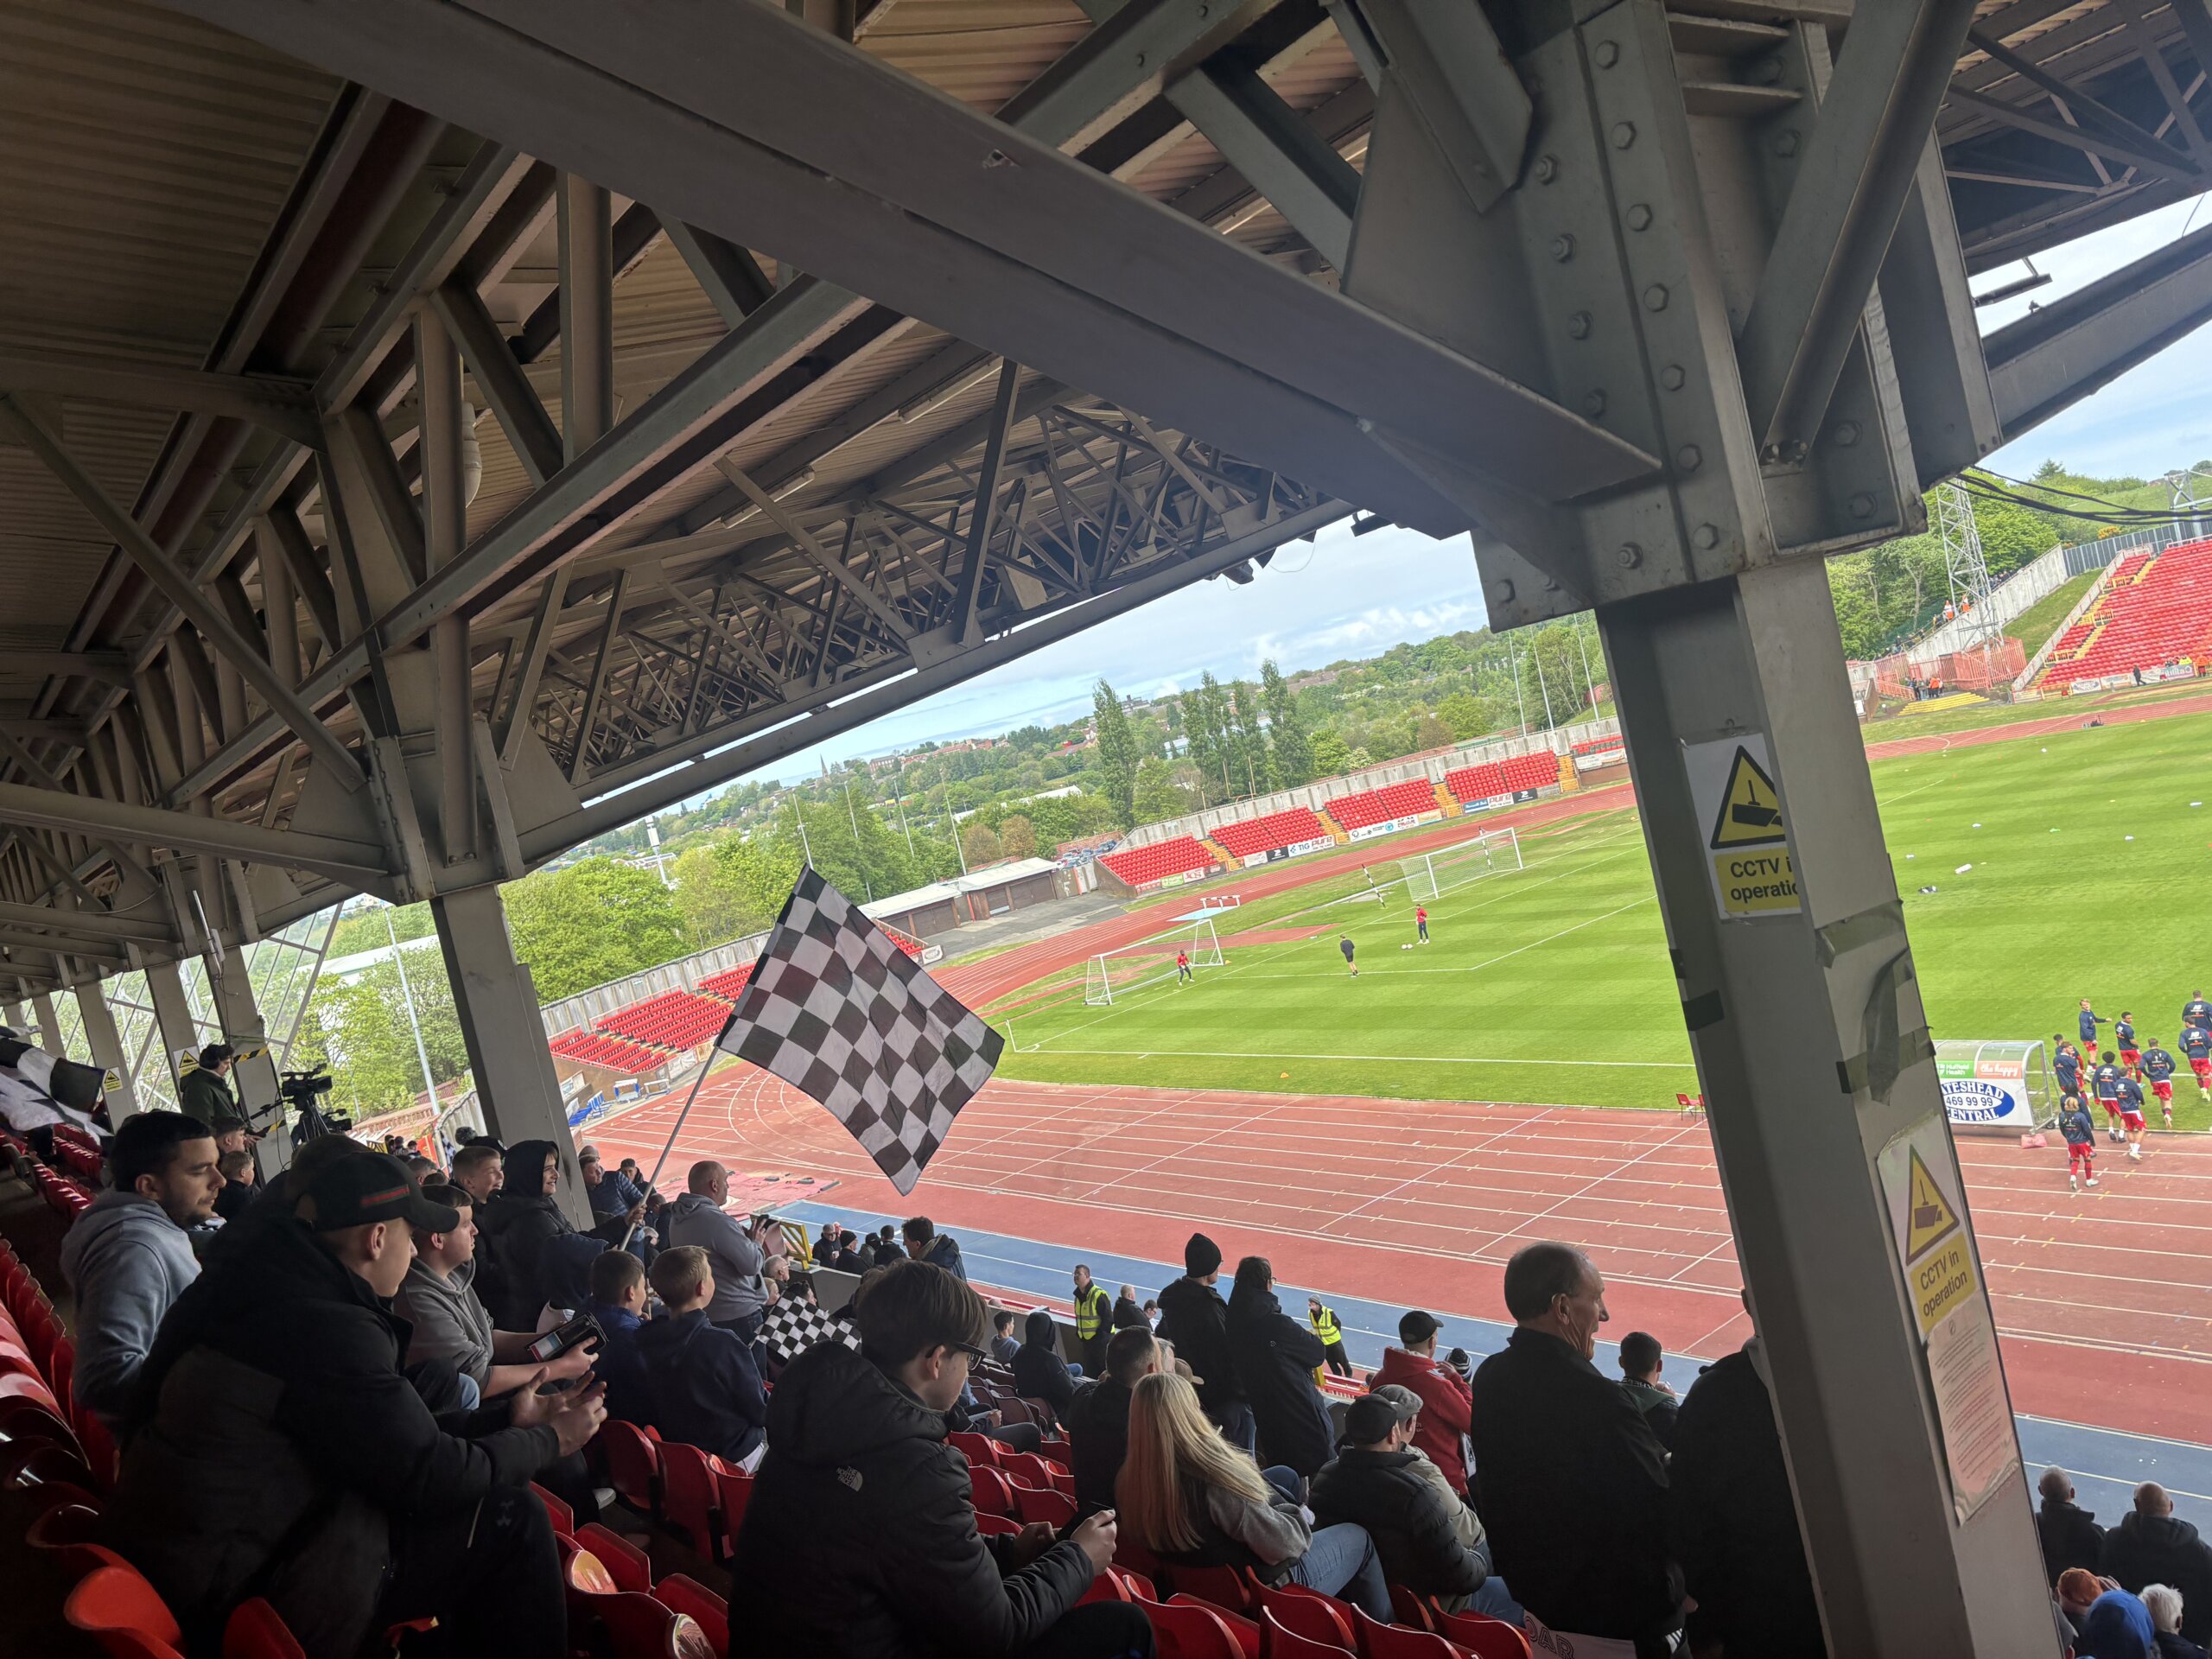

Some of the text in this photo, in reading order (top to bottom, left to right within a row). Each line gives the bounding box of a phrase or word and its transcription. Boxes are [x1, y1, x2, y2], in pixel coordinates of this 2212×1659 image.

[1298, 842, 1310, 851] TIG
[1730, 856, 1793, 878] CCTV i
[1946, 1096, 1993, 1107] 469 99 99
[1920, 1251, 1960, 1290] CCTV in
[1923, 1271, 1967, 1317] operation
